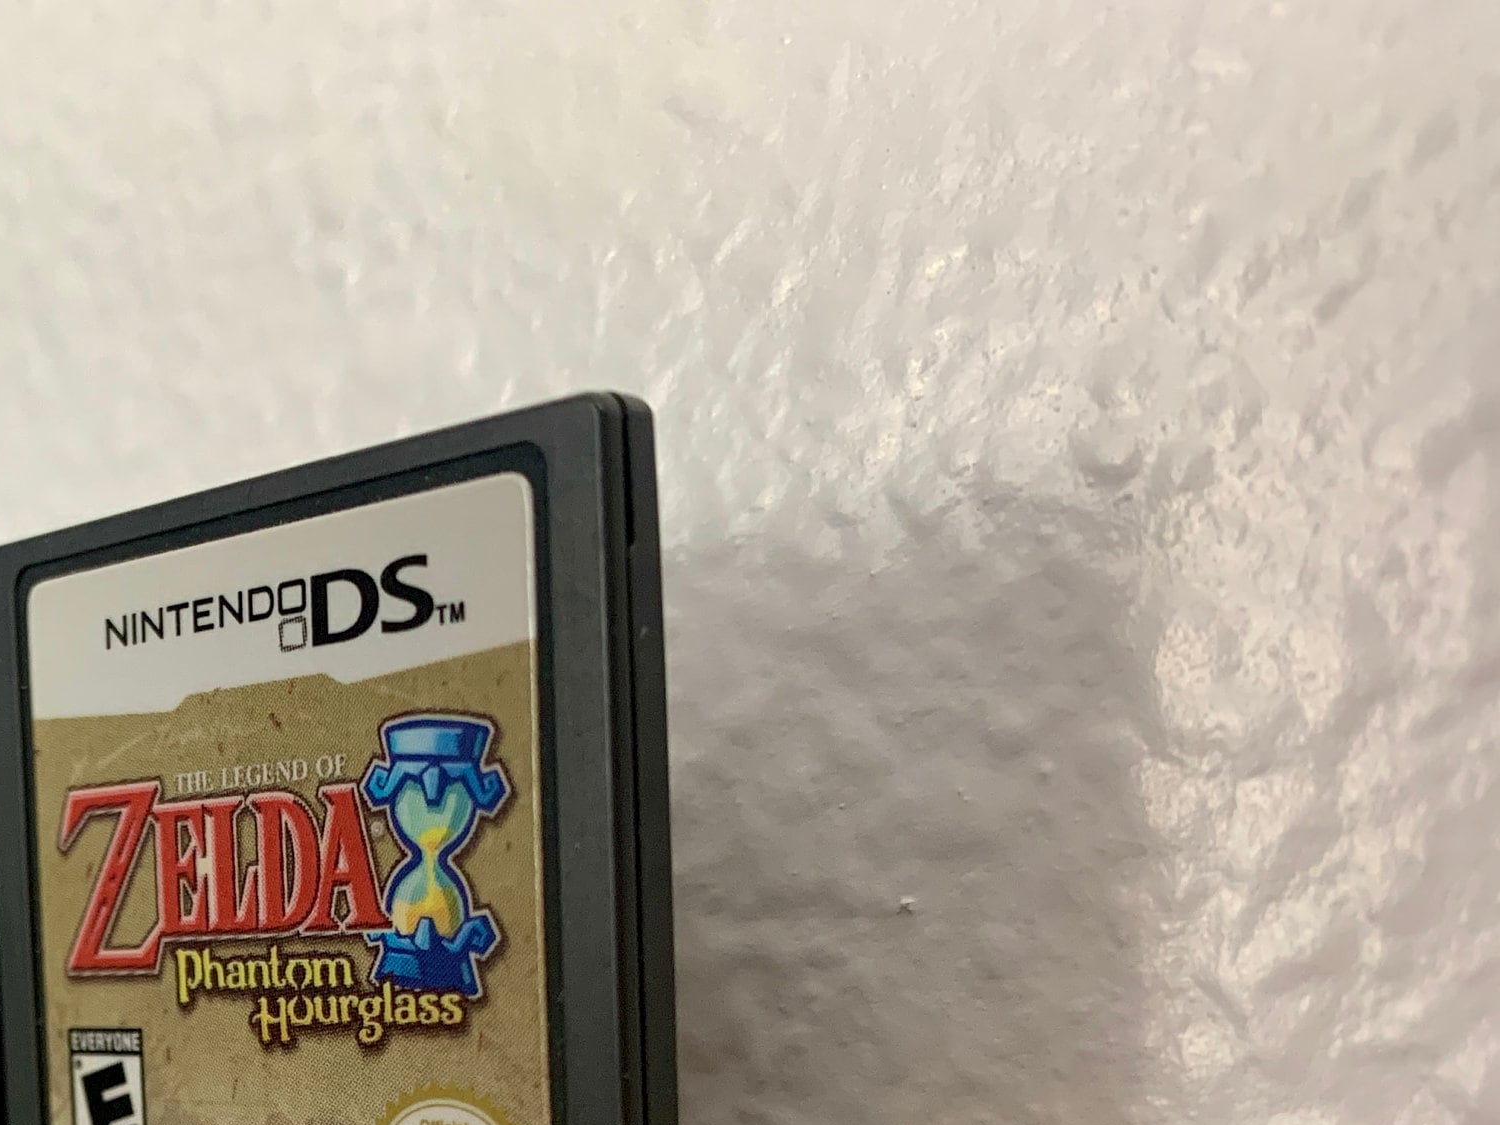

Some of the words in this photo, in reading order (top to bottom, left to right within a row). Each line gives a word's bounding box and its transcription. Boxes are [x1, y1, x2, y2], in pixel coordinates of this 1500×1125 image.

[105, 577, 306, 650] NINTENDO
[175, 771, 214, 794] THE
[221, 760, 309, 790] LEGEND
[315, 754, 347, 779] OF
[57, 780, 395, 978] ZELDA
[176, 944, 354, 1005] Phantom
[70, 1030, 141, 1051] EVERYONE
[252, 980, 464, 1044] Hourglass
